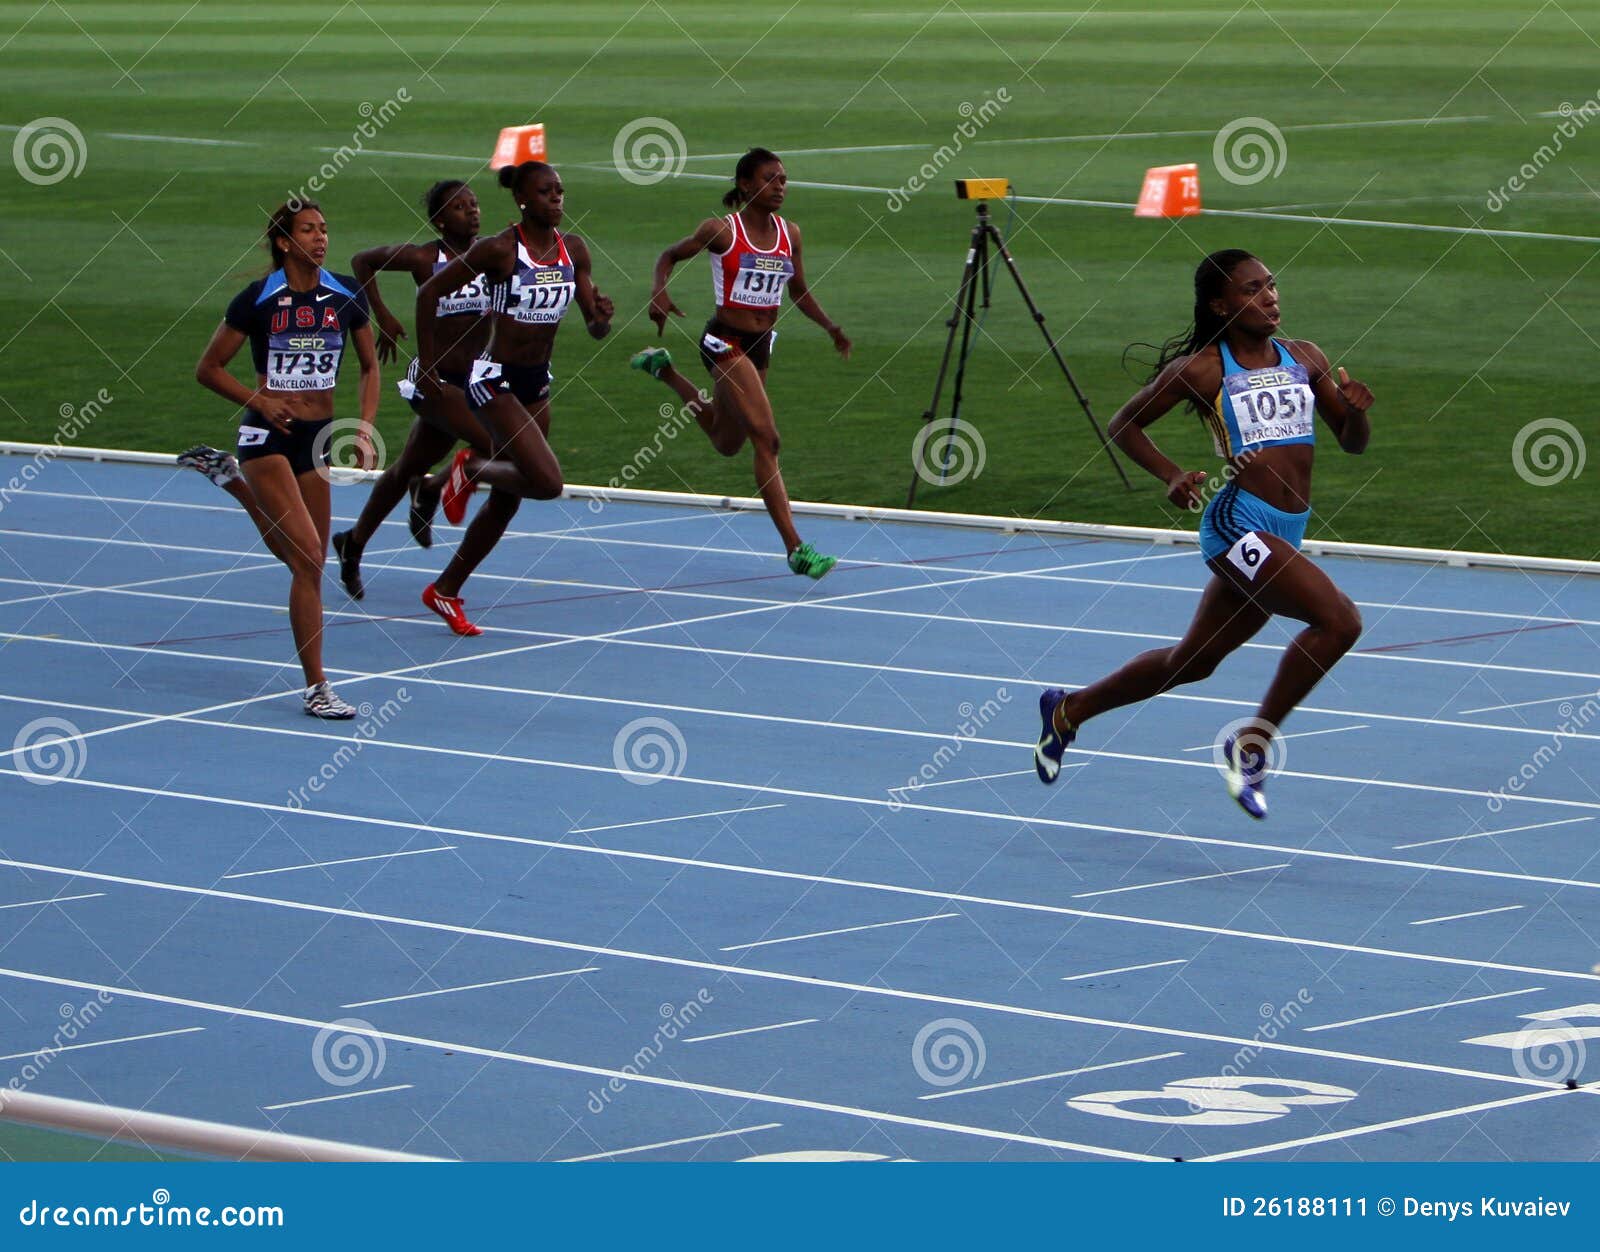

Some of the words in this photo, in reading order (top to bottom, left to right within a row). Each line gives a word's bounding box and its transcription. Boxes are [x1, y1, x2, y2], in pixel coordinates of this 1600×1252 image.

[1181, 176, 1198, 198] 75
[529, 285, 570, 309] 1271
[271, 306, 340, 334] USA
[274, 353, 334, 375] 1738
[270, 379, 317, 389] BARCELONA
[1241, 543, 1261, 567] 6
